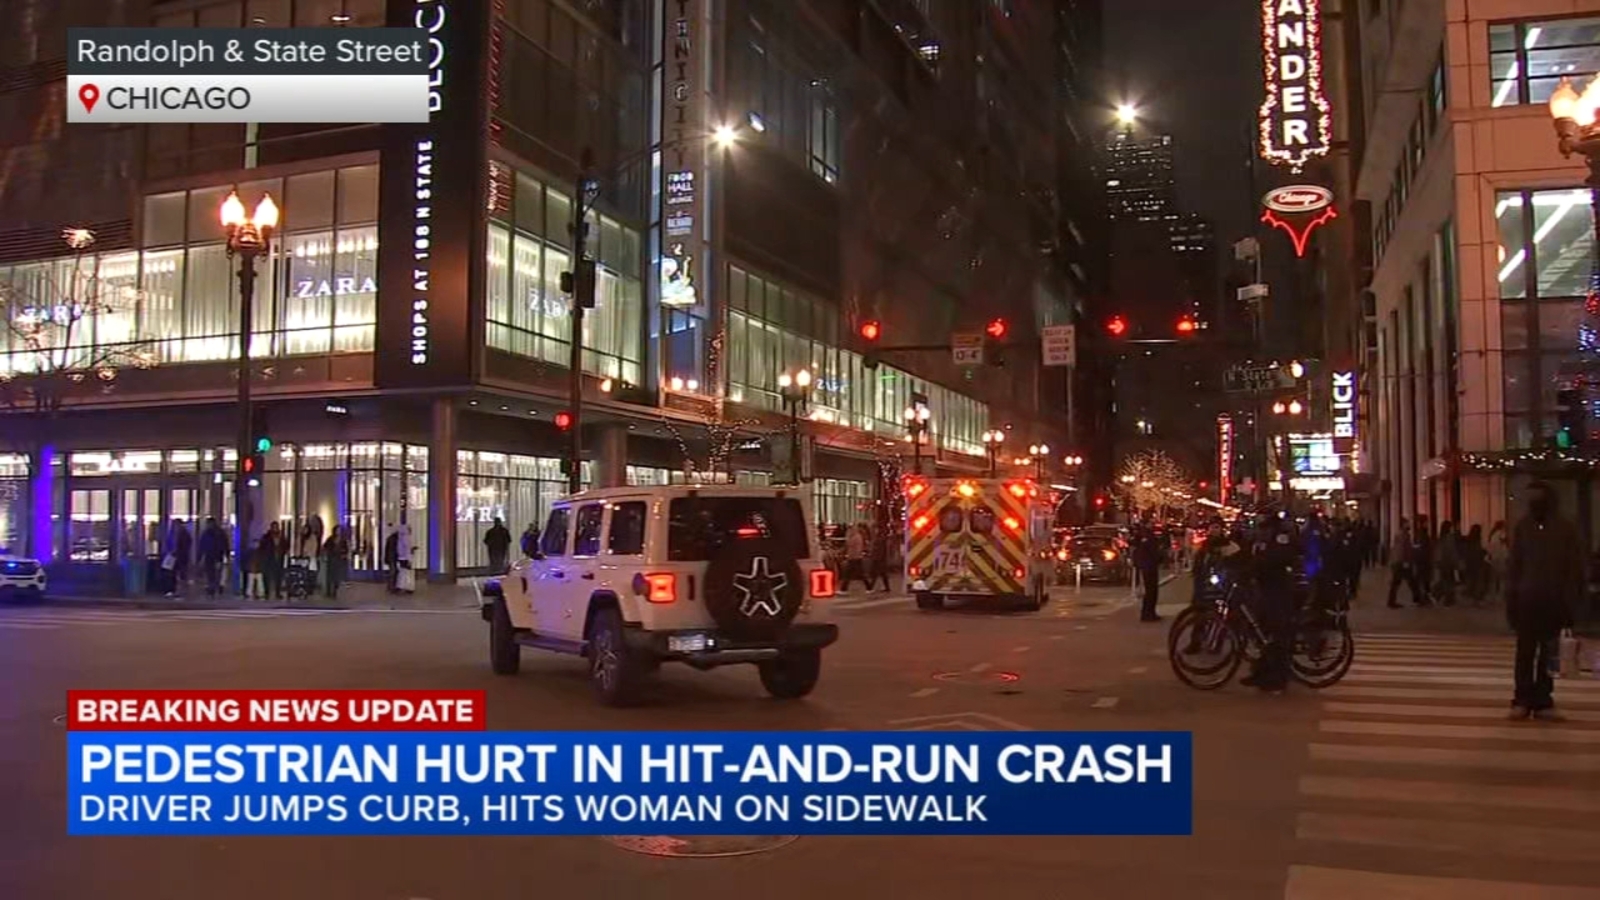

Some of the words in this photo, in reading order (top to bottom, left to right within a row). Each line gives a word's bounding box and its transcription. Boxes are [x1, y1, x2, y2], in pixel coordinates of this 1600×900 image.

[416, 0, 445, 112] BLOC
[416, 140, 433, 200] STATE
[416, 206, 431, 219] N
[415, 224, 430, 260] 108
[297, 277, 378, 299] ZARA
[414, 269, 428, 291] AT
[412, 299, 428, 365] SHOPS
[1332, 372, 1353, 437] BLICK
